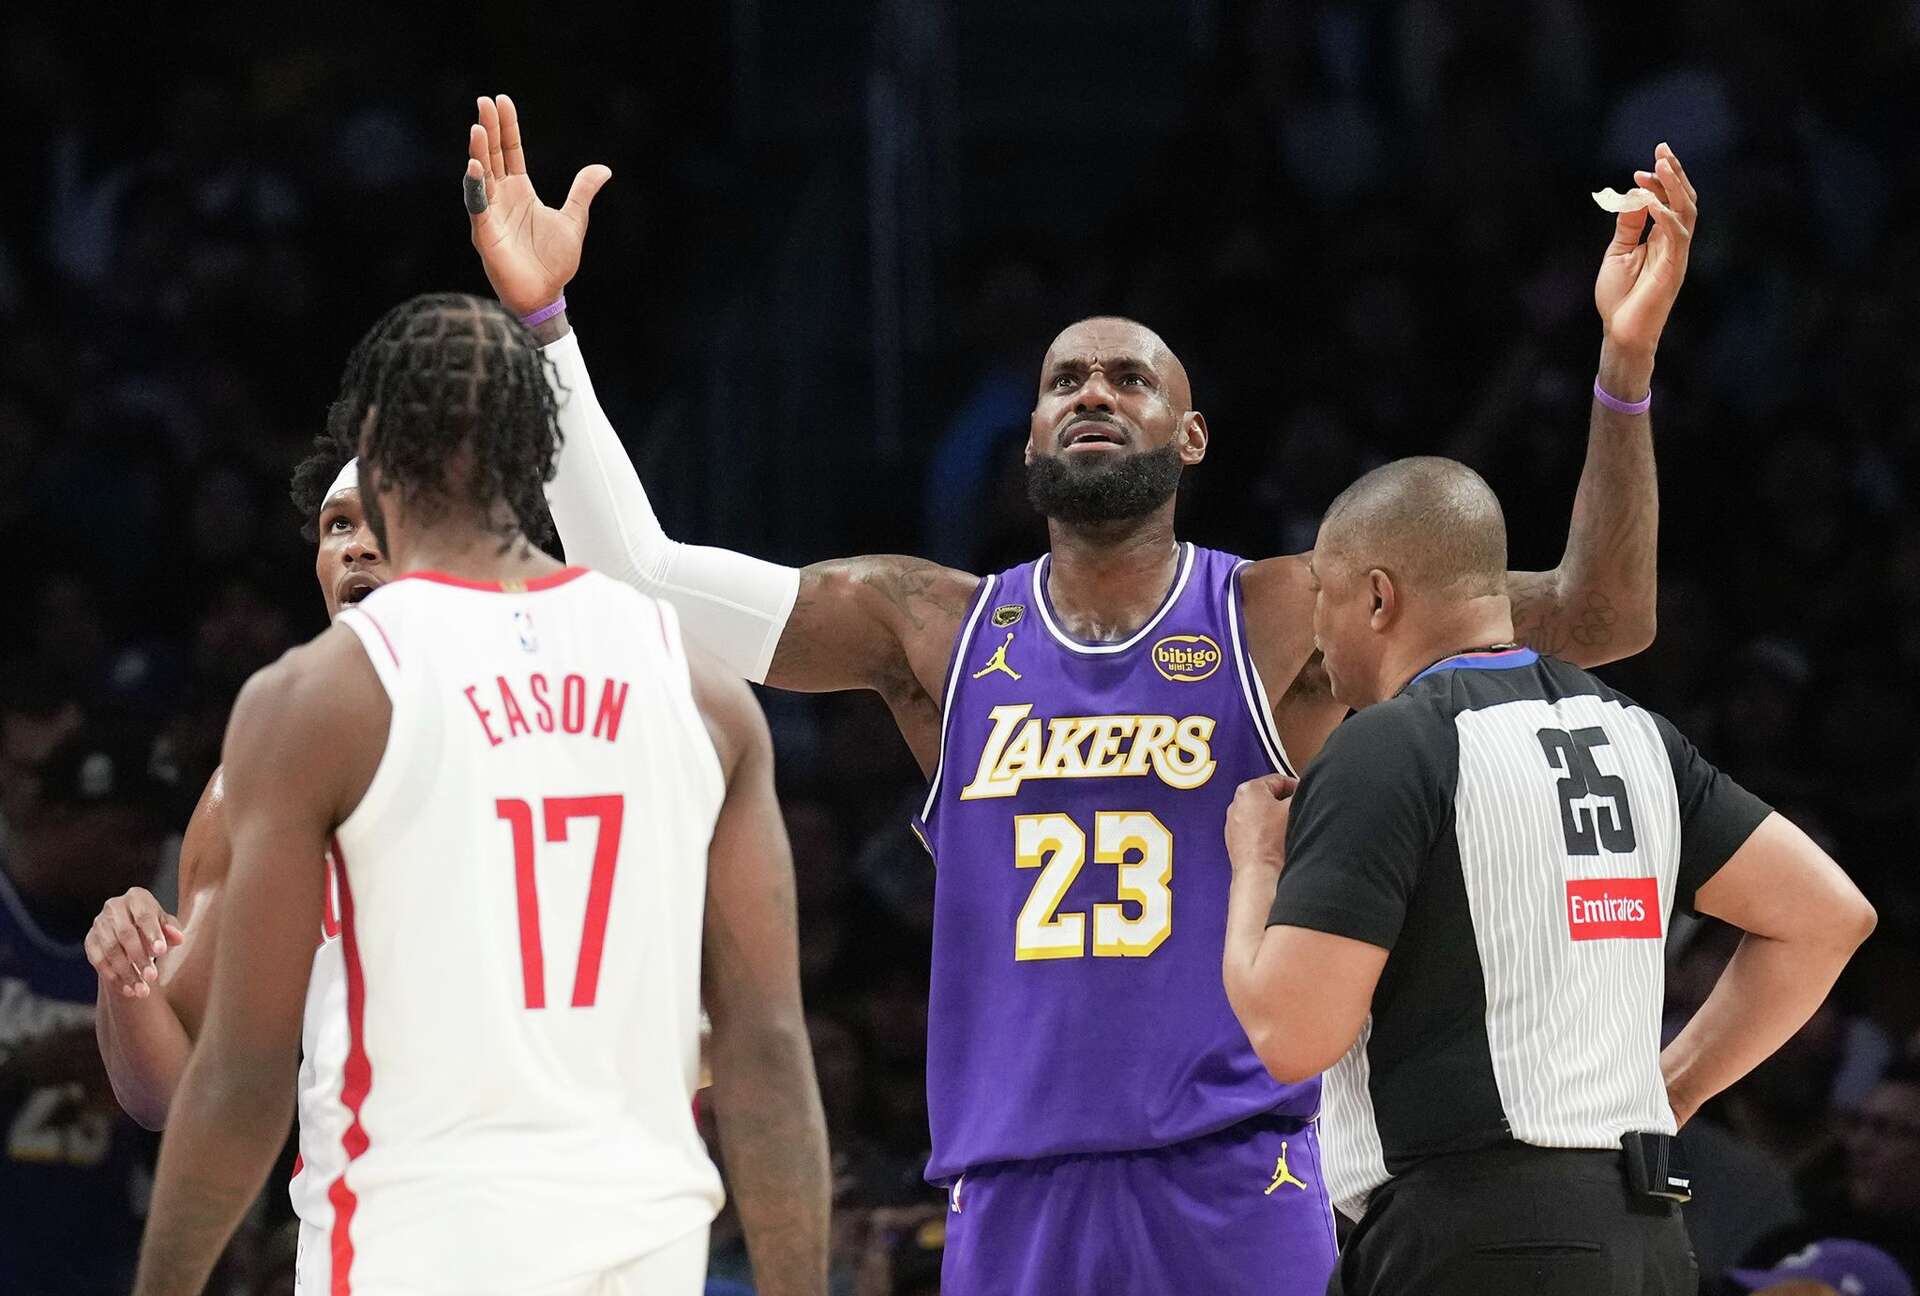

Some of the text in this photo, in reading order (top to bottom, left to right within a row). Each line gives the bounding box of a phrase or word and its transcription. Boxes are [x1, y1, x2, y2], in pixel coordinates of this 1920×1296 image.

[1158, 648, 1217, 668] bibigo
[1168, 664, 1194, 672] 비비고
[464, 673, 630, 747] EASON
[960, 703, 1217, 801] LAKERS
[1536, 726, 1637, 856] 25
[495, 794, 625, 1009] 17
[1013, 811, 1174, 961] 23
[1570, 893, 1646, 924] Emirates
